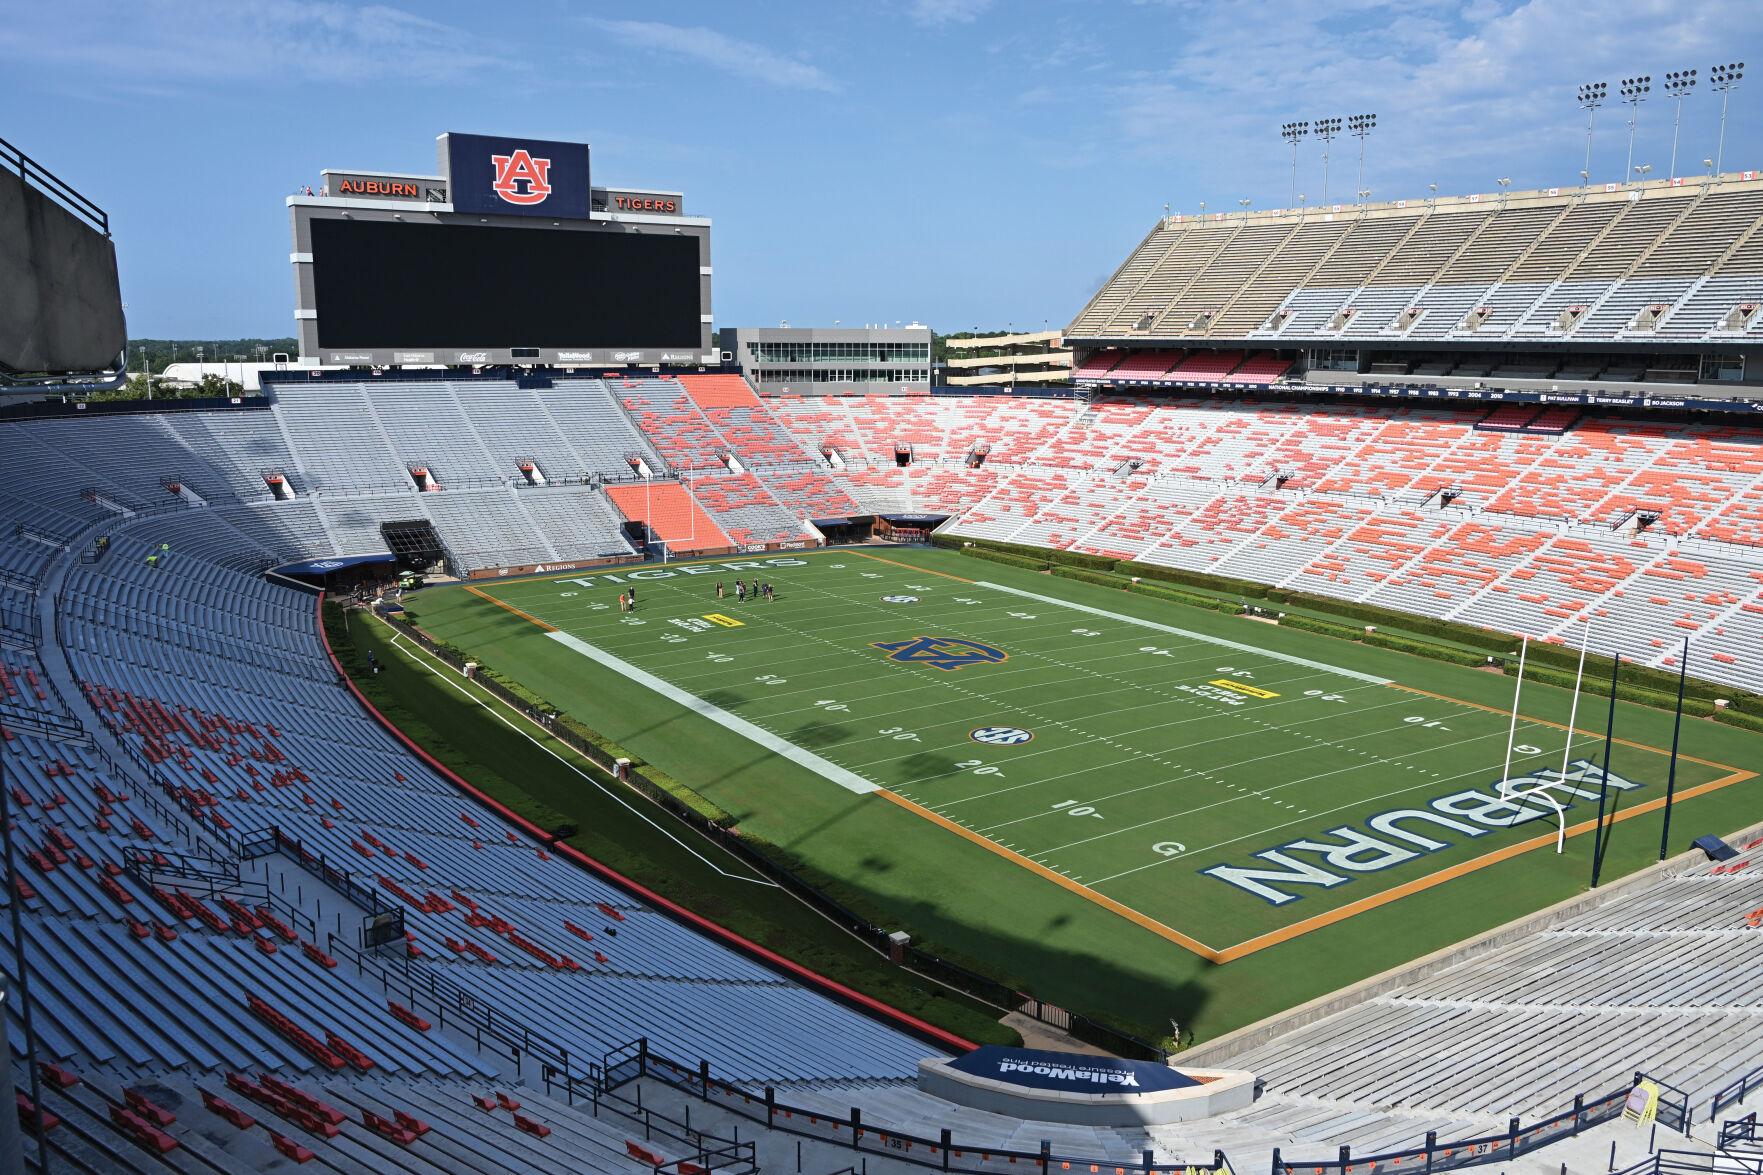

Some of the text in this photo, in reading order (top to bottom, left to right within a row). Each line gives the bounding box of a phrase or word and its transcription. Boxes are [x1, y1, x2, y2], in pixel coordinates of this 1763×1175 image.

[340, 179, 418, 197] AUBURN
[615, 197, 675, 212] TIGERS
[460, 352, 487, 362] Coca-Cola
[546, 563, 576, 571] REGIONS
[553, 558, 808, 588] TIGERS
[755, 674, 787, 685] 50
[1197, 685, 1248, 700] FIELD
[1303, 690, 1342, 702] 20
[814, 699, 848, 711] 40
[1403, 716, 1442, 728] 10
[879, 727, 917, 741] 30
[1512, 744, 1542, 755] G
[956, 759, 999, 776] 20
[1051, 799, 1096, 817] 10
[1202, 758, 1644, 905] AUBURN
[1152, 841, 1187, 857] G
[1002, 1057, 1135, 1077] Pressure Treated Pine
[999, 1062, 1140, 1087] YellaWood
[891, 1138, 902, 1149] 35
[1477, 1144, 1488, 1154] 37
